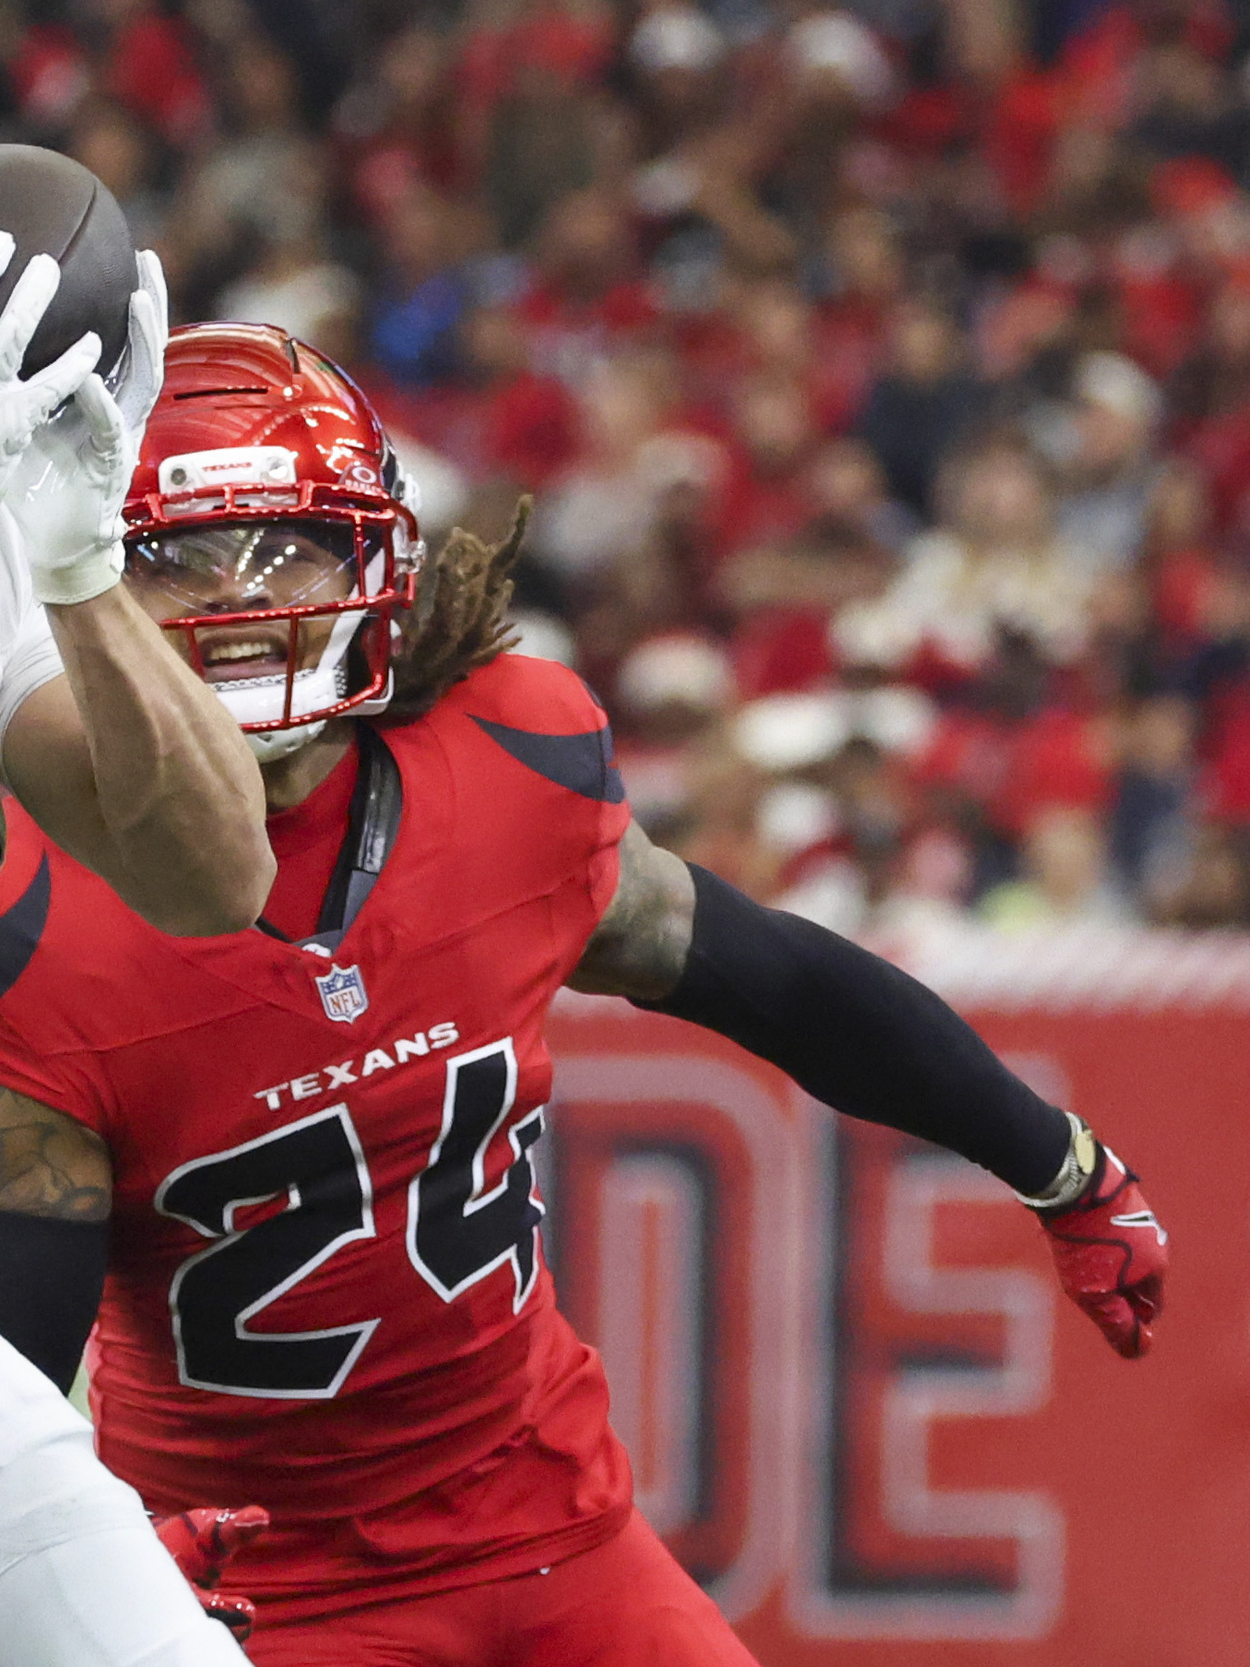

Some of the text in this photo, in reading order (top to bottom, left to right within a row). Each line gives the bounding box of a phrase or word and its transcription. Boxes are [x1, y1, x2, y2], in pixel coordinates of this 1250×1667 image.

[201, 461, 252, 472] TEXANS
[329, 990, 361, 1015] NFL
[253, 1021, 459, 1110] TEXANS
[154, 1036, 546, 1398] 24
